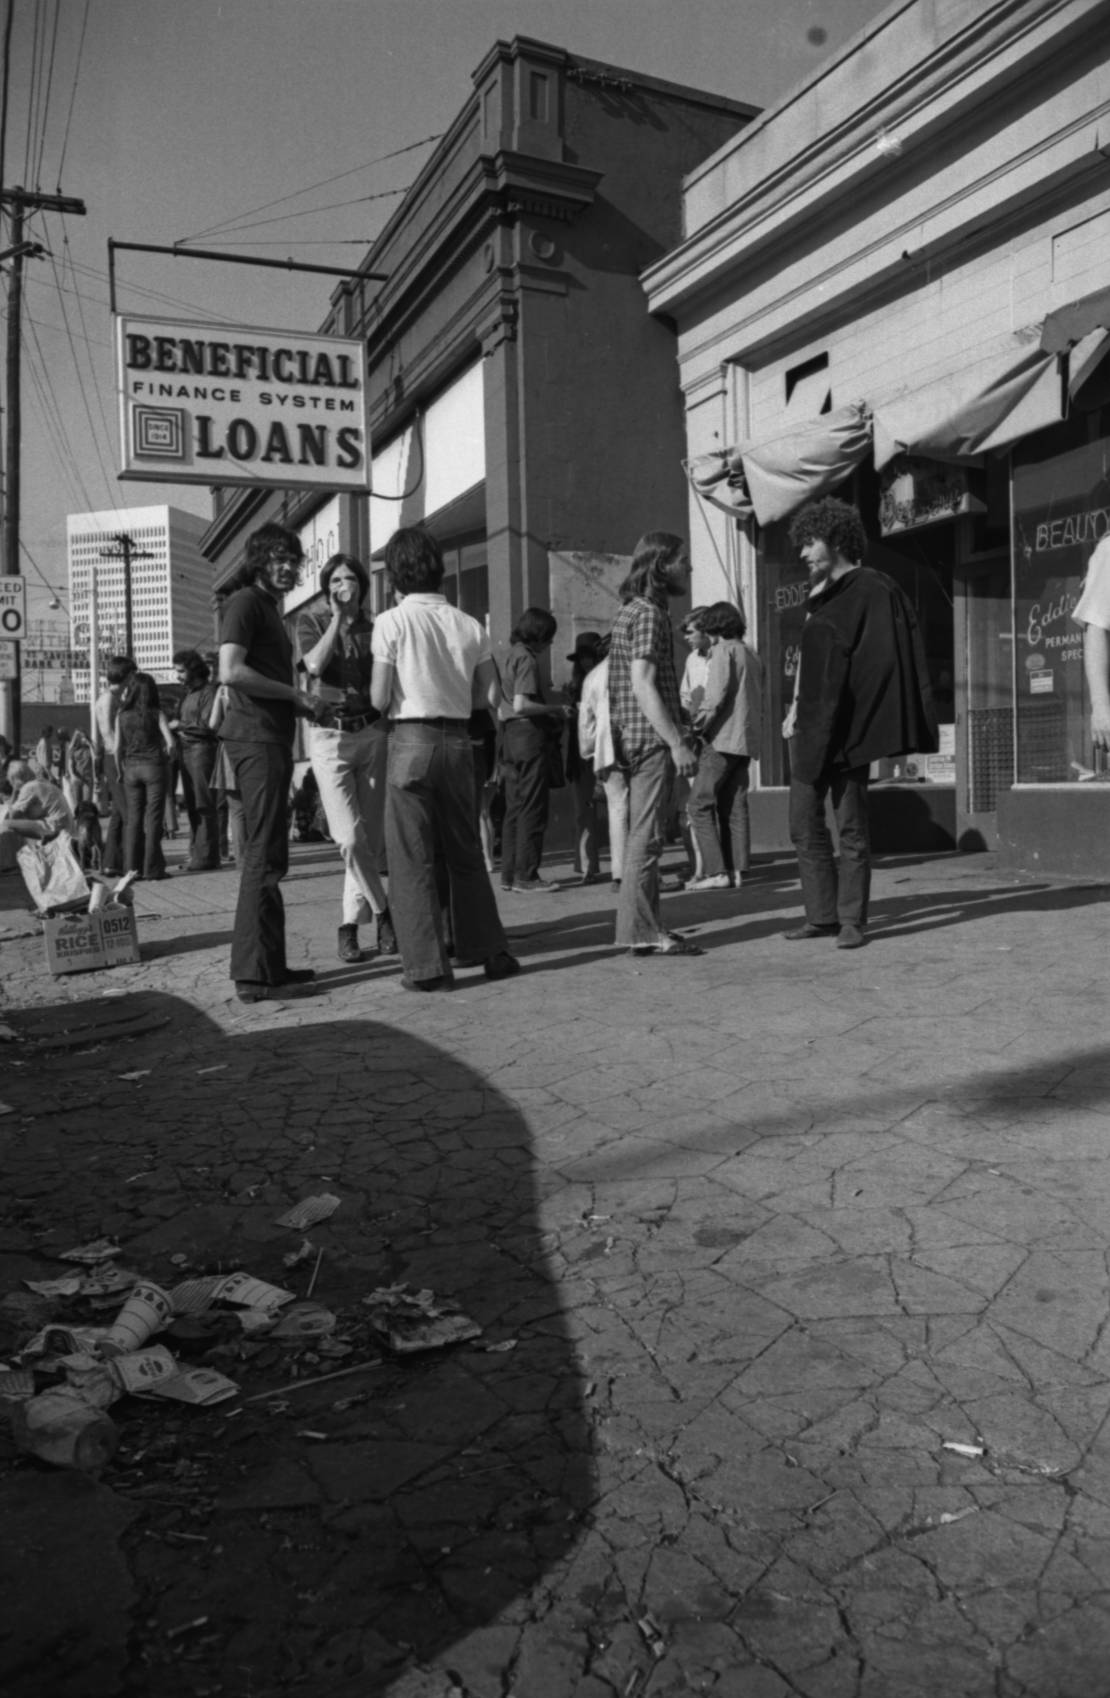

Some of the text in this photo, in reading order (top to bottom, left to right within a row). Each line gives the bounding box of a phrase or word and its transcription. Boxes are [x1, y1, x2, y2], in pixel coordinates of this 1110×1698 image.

[126, 333, 359, 389] BENEFICIAL
[132, 381, 355, 413] FINANCE SYSTEM
[195, 415, 361, 469] LOANS
[103, 916, 130, 934] 0512
[55, 933, 99, 951] RICE
